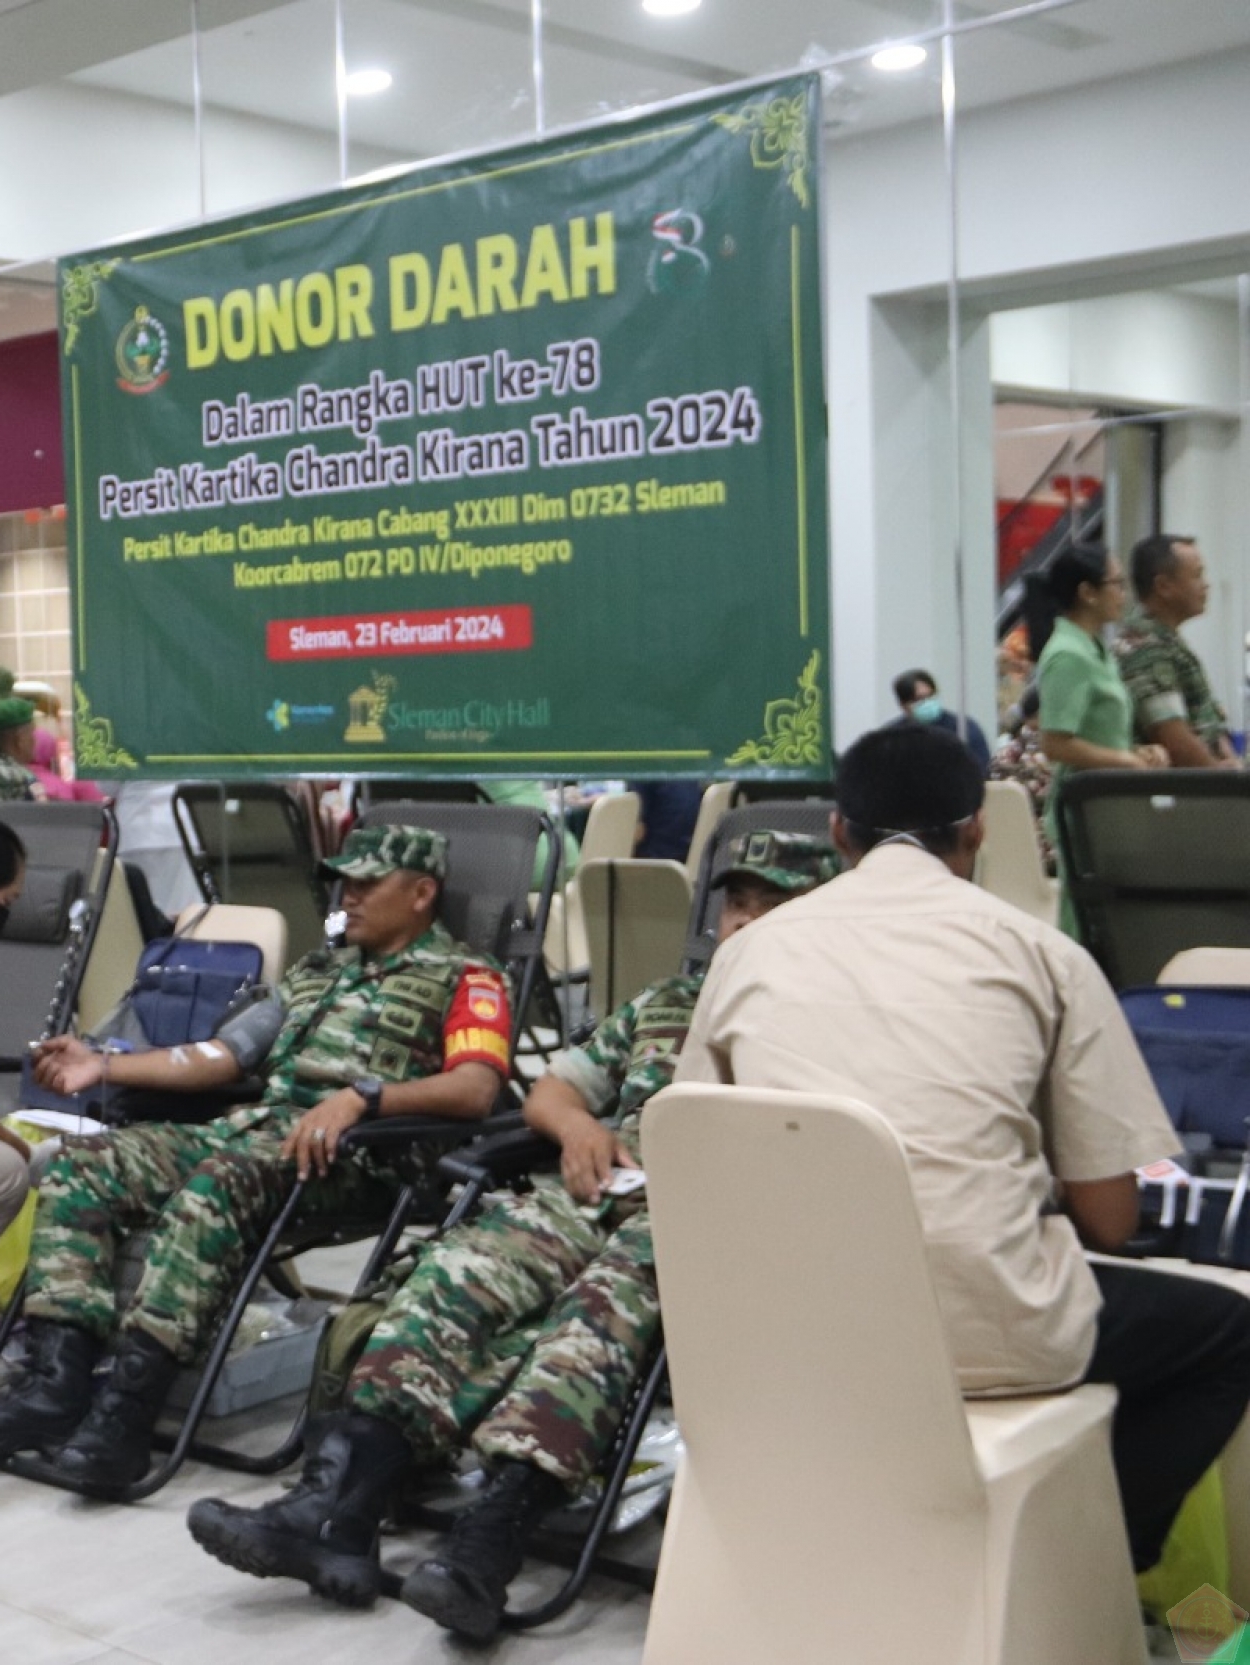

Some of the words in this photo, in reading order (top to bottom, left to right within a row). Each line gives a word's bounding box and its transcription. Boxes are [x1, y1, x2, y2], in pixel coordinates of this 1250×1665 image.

[183, 264, 374, 369] DONOR
[389, 211, 616, 332] DARAH
[203, 393, 297, 446] Dalam
[297, 370, 412, 437] Rangka
[417, 354, 490, 413] HUT
[494, 338, 599, 402] ke-78
[99, 466, 177, 520] Persit
[179, 454, 281, 508] Kartika
[285, 435, 412, 496] Chandra
[417, 428, 529, 482] Kirana
[531, 407, 643, 466] Tahun
[647, 386, 762, 453] 2024
[123, 534, 172, 562] Persit
[174, 526, 235, 556] Kartika
[238, 518, 307, 549] Chandra
[313, 515, 373, 542] Kirana
[377, 507, 448, 539] Cabang
[455, 495, 518, 528] XXXIII
[522, 492, 566, 523] Dim
[570, 483, 631, 518] 0732
[635, 478, 726, 511] Sleman
[234, 556, 341, 588] Koorcabrem
[344, 551, 382, 578] 072
[387, 547, 414, 576] PD
[419, 538, 572, 578] IV/Diponegoro
[289, 625, 351, 650] Sleman,
[355, 622, 376, 646] 23
[380, 618, 450, 645] Februari
[454, 615, 504, 640] 2024
[387, 702, 458, 730] Sleman
[464, 700, 502, 736] City
[507, 697, 549, 728] Hall
